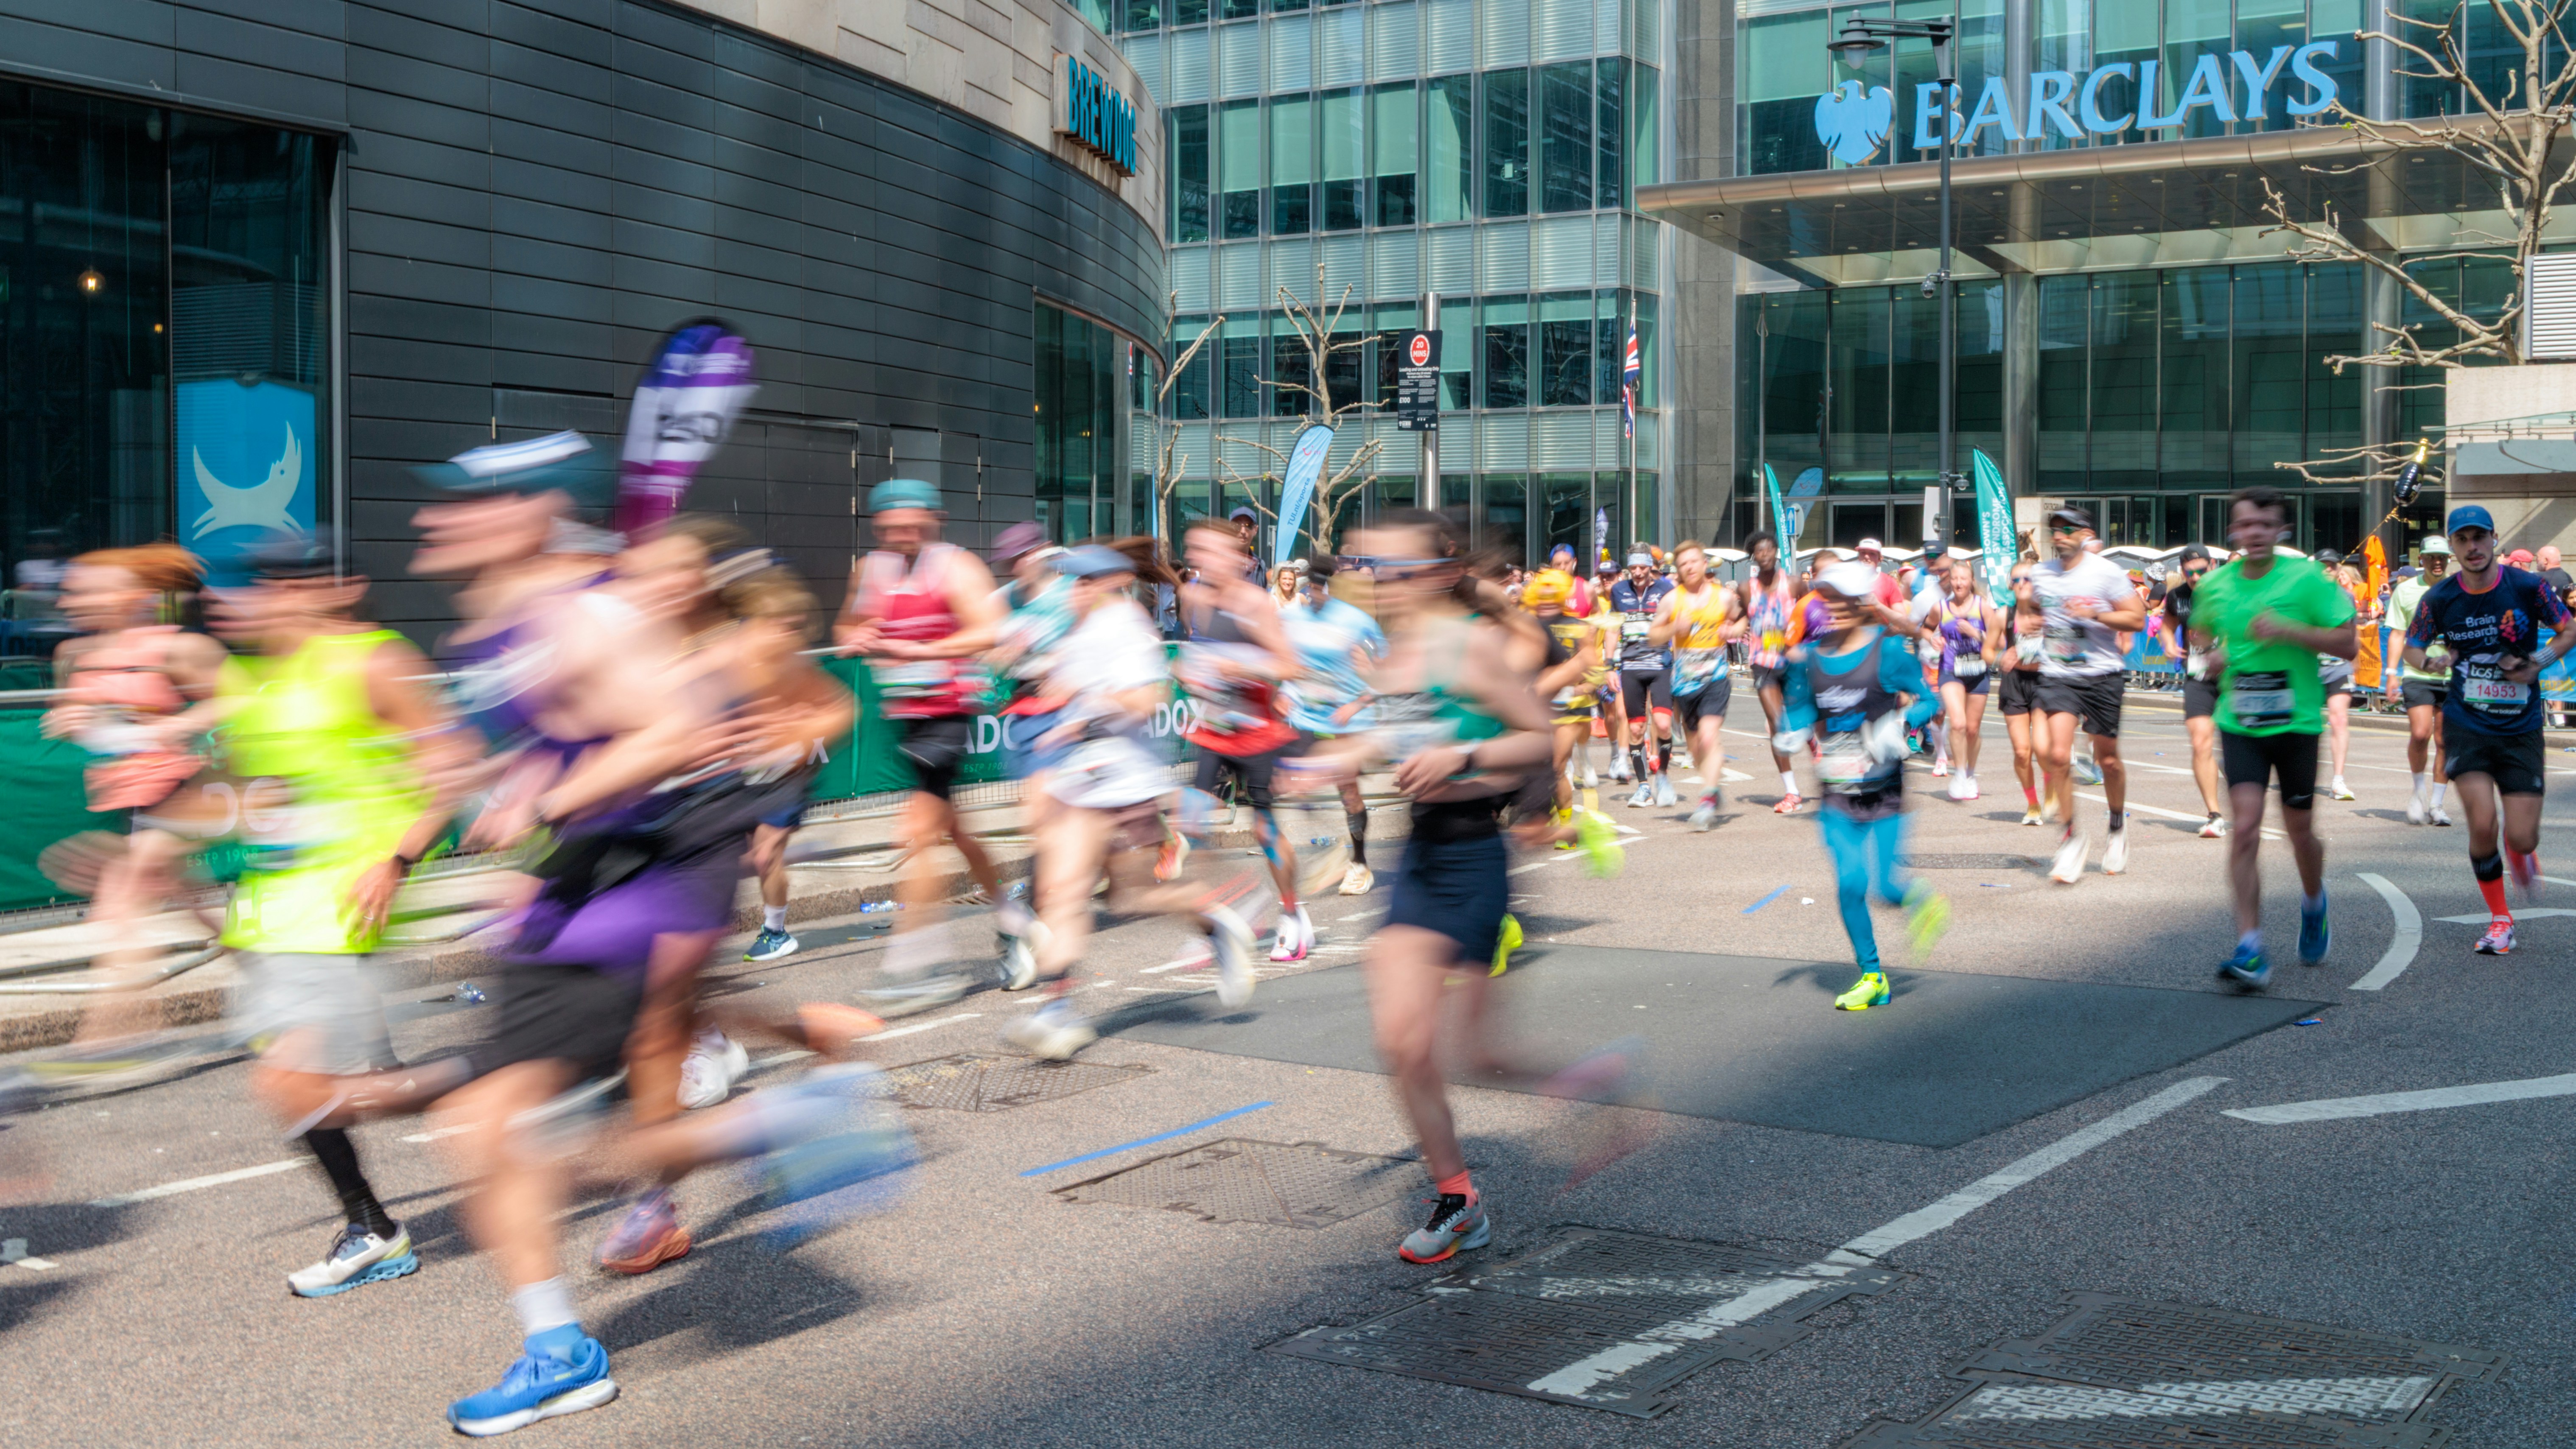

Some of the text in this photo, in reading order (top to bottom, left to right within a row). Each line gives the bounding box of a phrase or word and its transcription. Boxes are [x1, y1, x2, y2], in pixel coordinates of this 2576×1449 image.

[1913, 41, 2339, 149] BARCLAYS
[1069, 55, 1136, 176] BREWDOG
[1287, 478, 1311, 526] TUI.nl/sports
[1982, 512, 1991, 554] DOWN'S
[1992, 498, 2000, 553] SYNDROME
[2466, 614, 2496, 627] Brain
[2447, 624, 2498, 641] Research
[2484, 636, 2500, 646] UK
[2471, 665, 2492, 678] tcs
[2477, 684, 2516, 698] 14953
[1138, 699, 1209, 738] ADOX
[987, 762, 1008, 770] 1908
[226, 848, 258, 862] 1908
